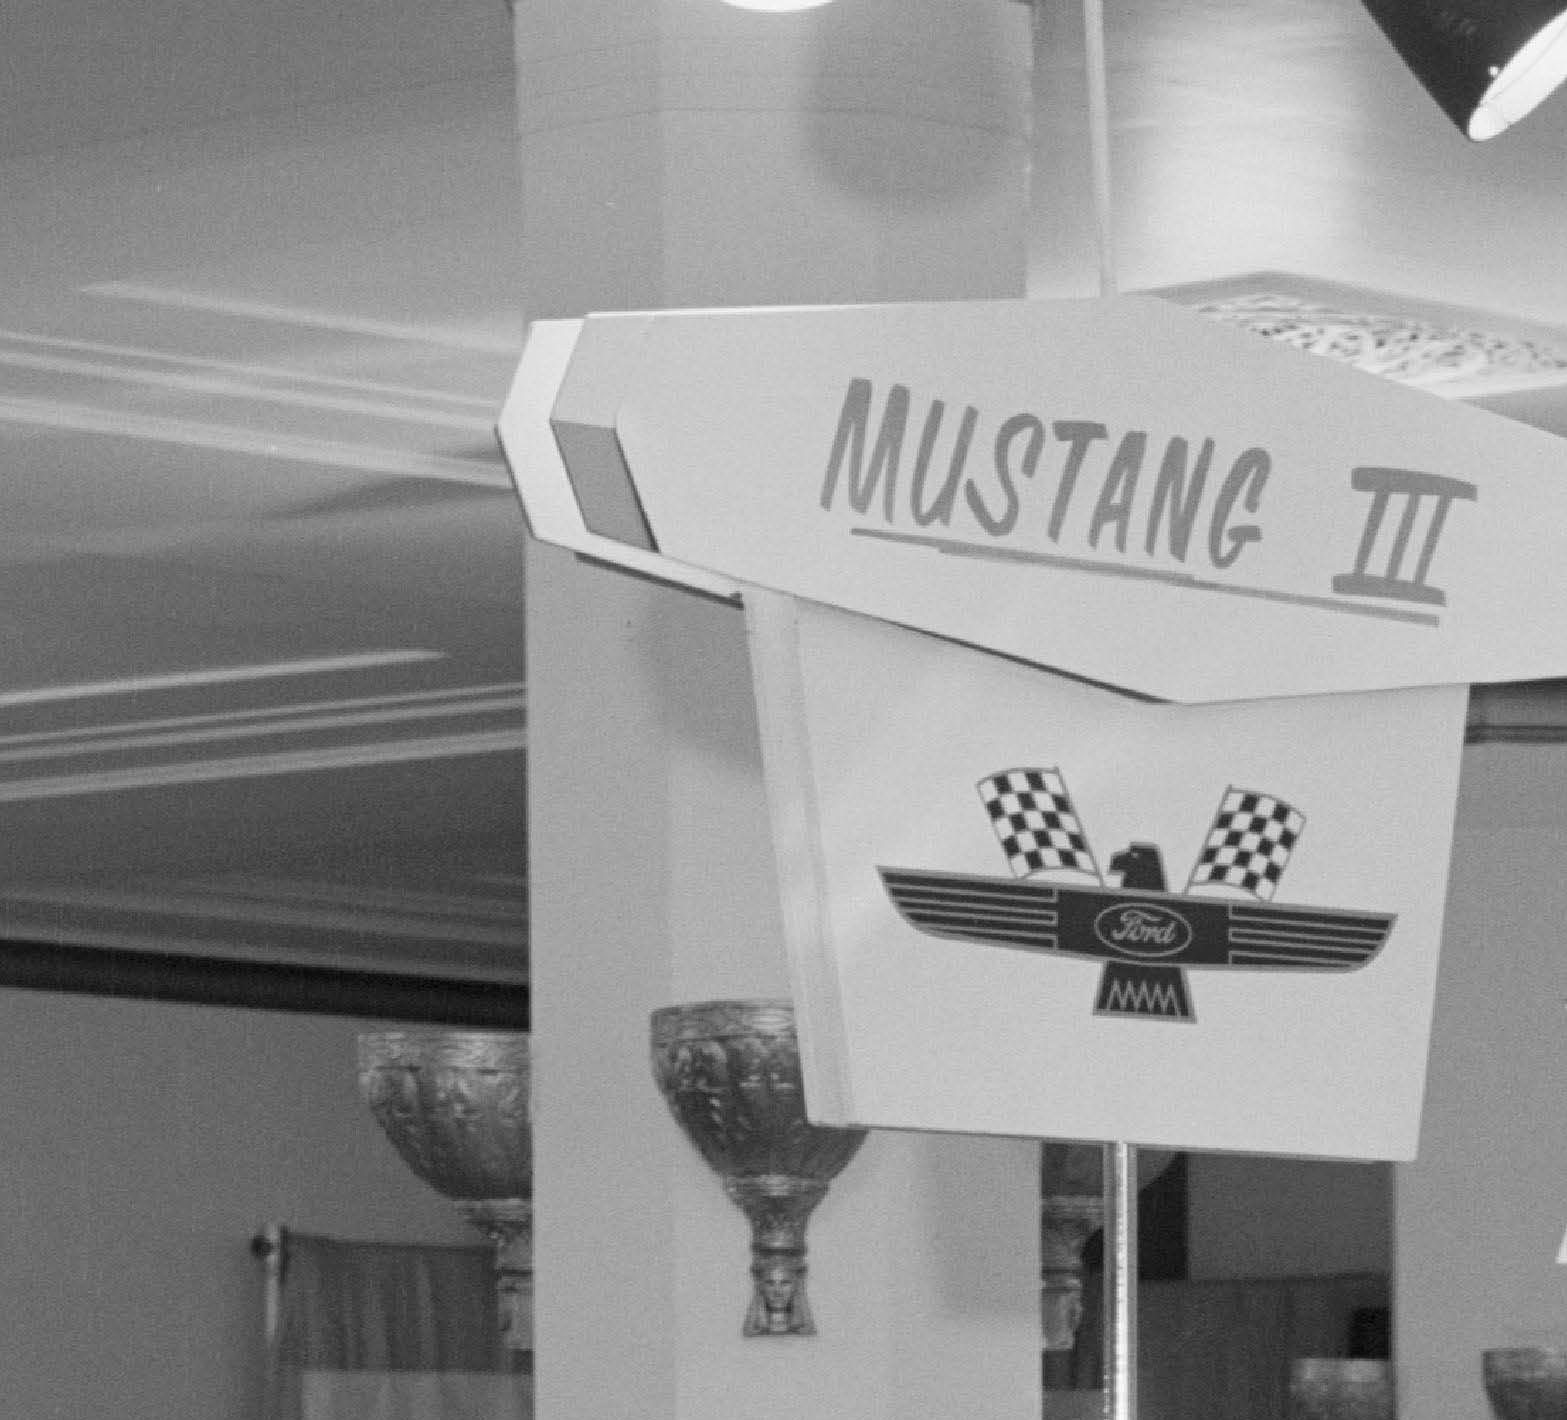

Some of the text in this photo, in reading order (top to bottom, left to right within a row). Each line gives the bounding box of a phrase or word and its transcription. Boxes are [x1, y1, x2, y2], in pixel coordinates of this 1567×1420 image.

[820, 376, 1478, 606] MUSTANG III
[1111, 909, 1177, 944] Ford
